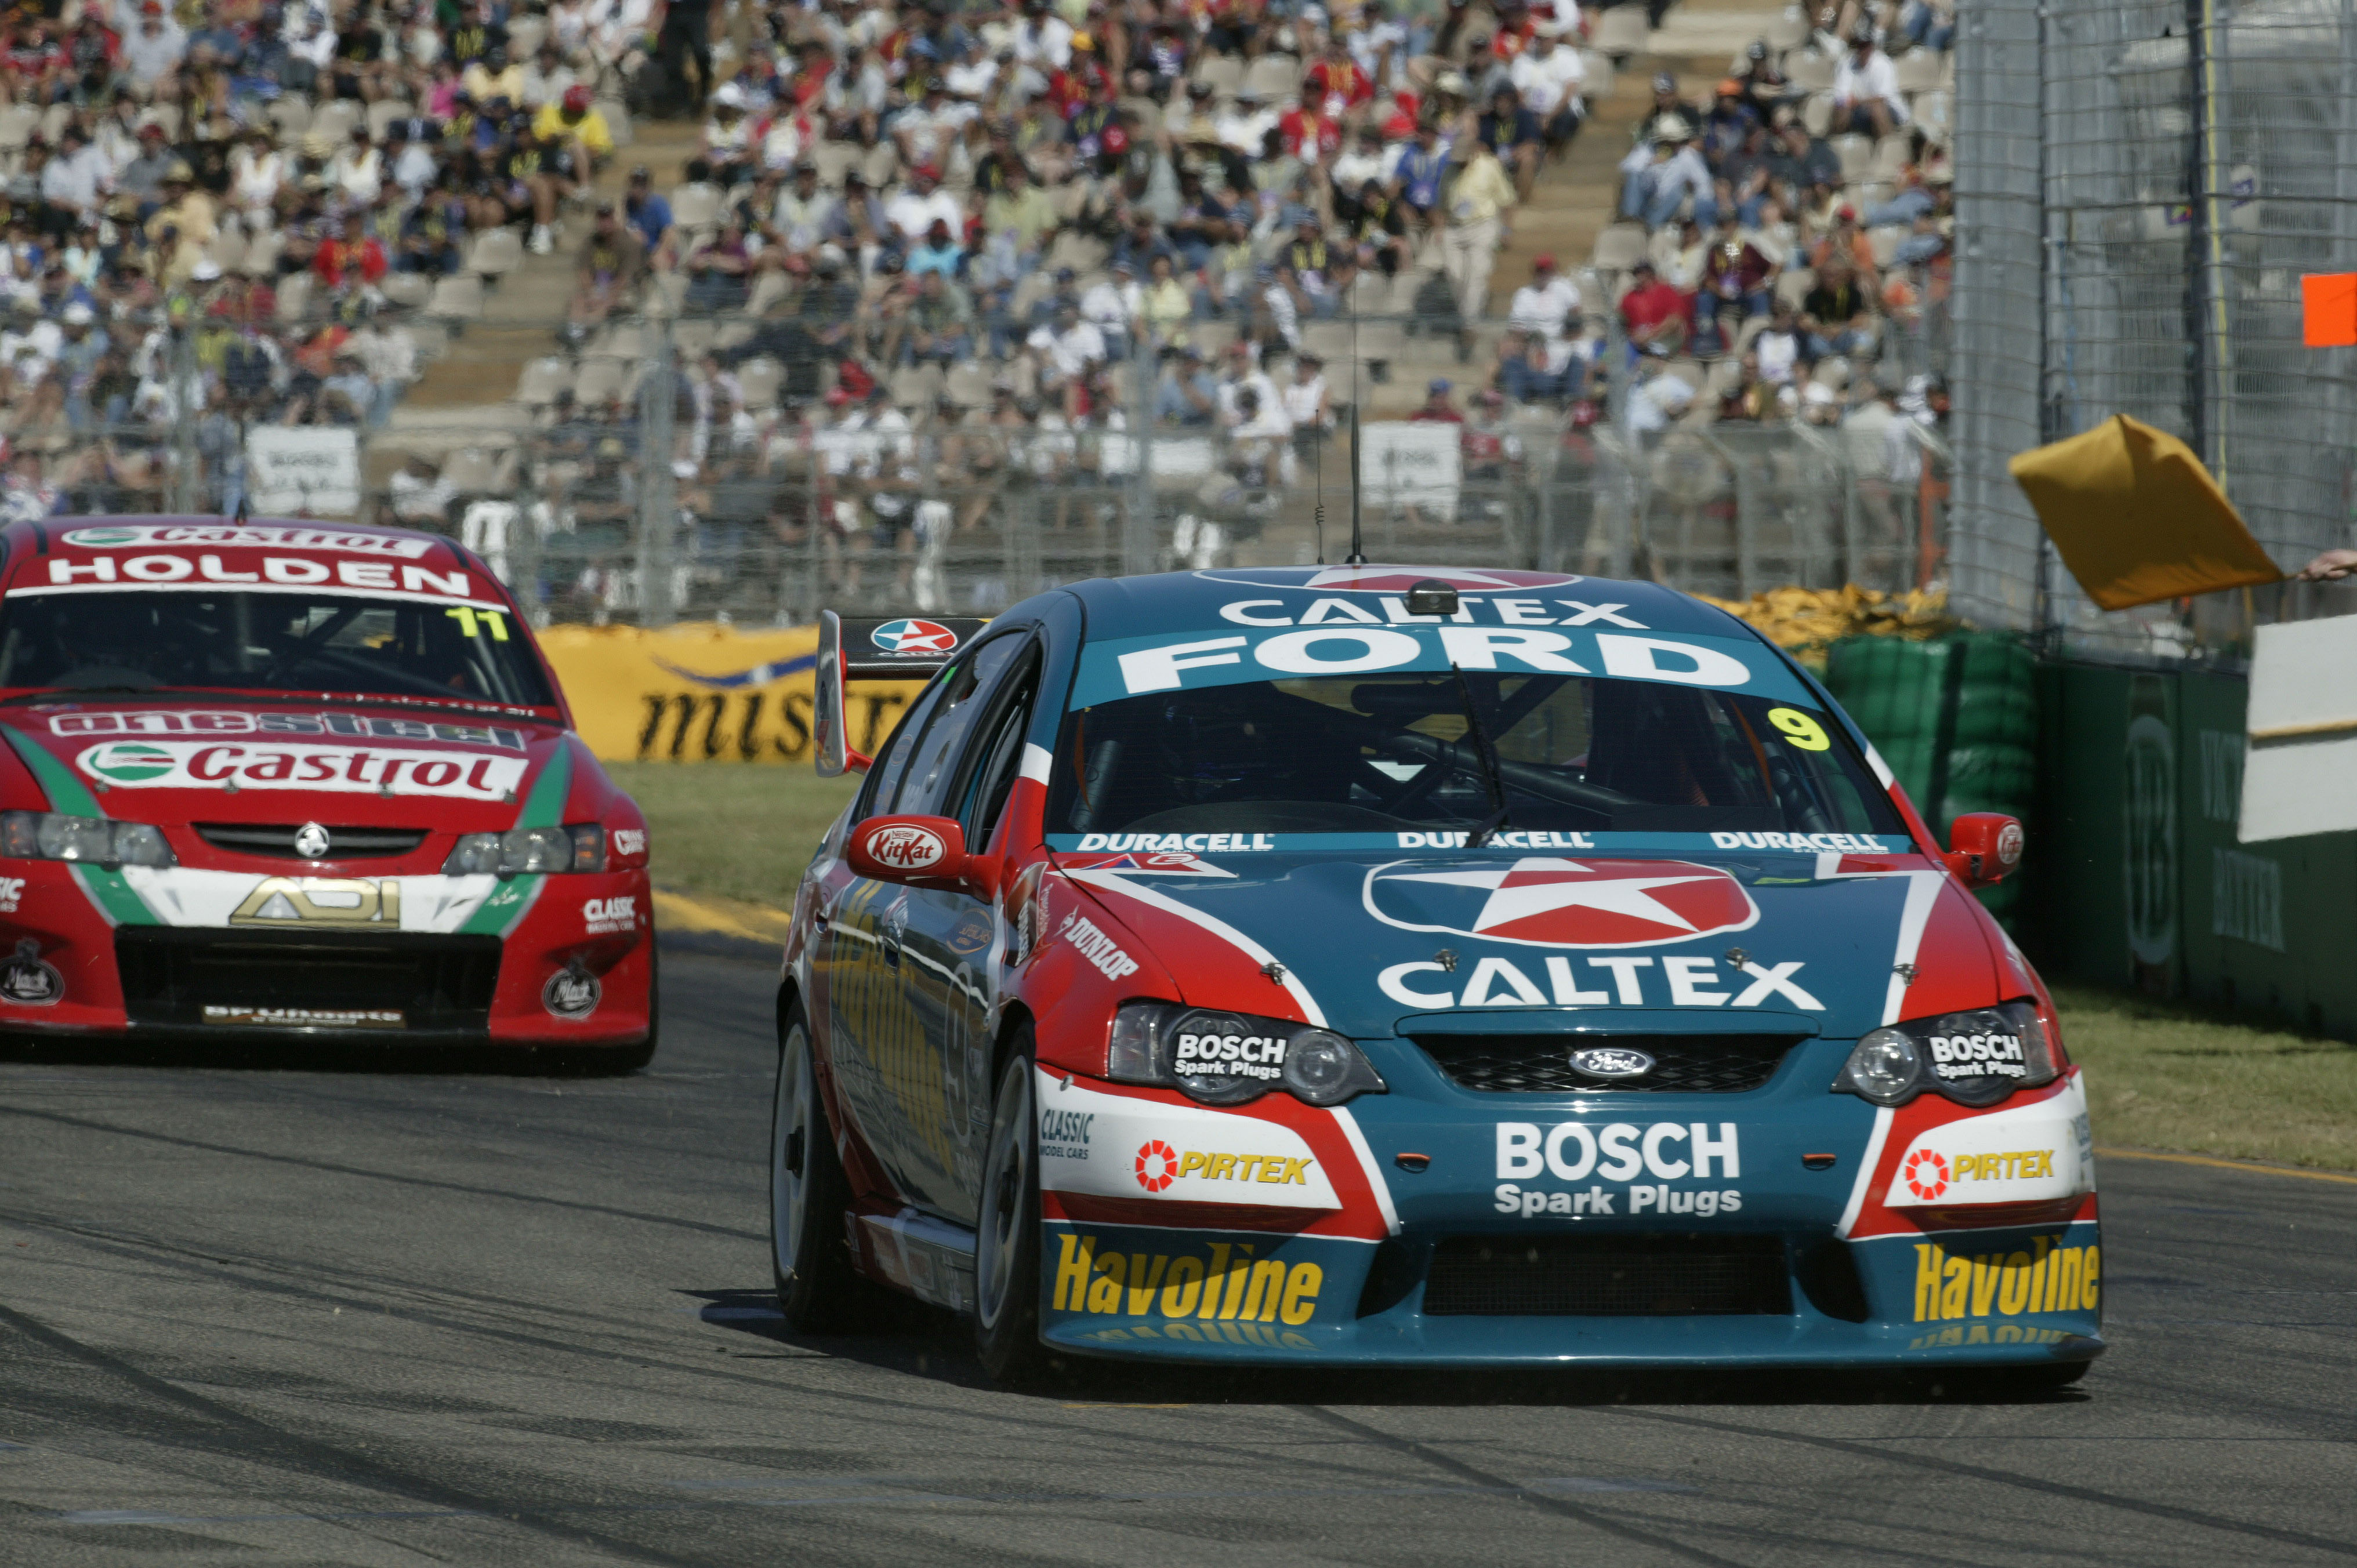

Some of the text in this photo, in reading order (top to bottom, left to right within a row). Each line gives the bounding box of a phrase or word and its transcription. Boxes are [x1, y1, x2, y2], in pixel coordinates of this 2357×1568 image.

[49, 554, 470, 596] HOLDEN
[445, 606, 509, 640] 11
[1220, 597, 1651, 629] CALTEX
[1116, 626, 1752, 695] FORD
[1768, 707, 1831, 752] 9
[186, 746, 496, 792] Castrol
[1076, 833, 1275, 851] DURACELL
[1709, 832, 1889, 851] DURACELL
[229, 876, 400, 927] ADI
[1064, 916, 1140, 981] DUNLOP
[1377, 955, 1826, 1011] CALTEX
[1176, 1034, 1287, 1064] BOSCH
[1588, 1051, 1637, 1070] Ford
[1928, 1035, 2024, 1062] BOSCH
[1174, 1059, 1282, 1080] Spark Plugs
[1936, 1061, 2026, 1079] Spark Plugs
[1042, 1108, 1094, 1145] CLASSIC
[1039, 1145, 1089, 1160] MODEL CARS
[1178, 1150, 1314, 1185] PIRTEK
[1496, 1121, 1740, 1182] BOSCH
[1952, 1149, 2055, 1183] PIRTEK
[1494, 1184, 1742, 1218] Spark Plugs
[1052, 1233, 1323, 1326] Havoline
[1913, 1235, 2099, 1322] Havoline
